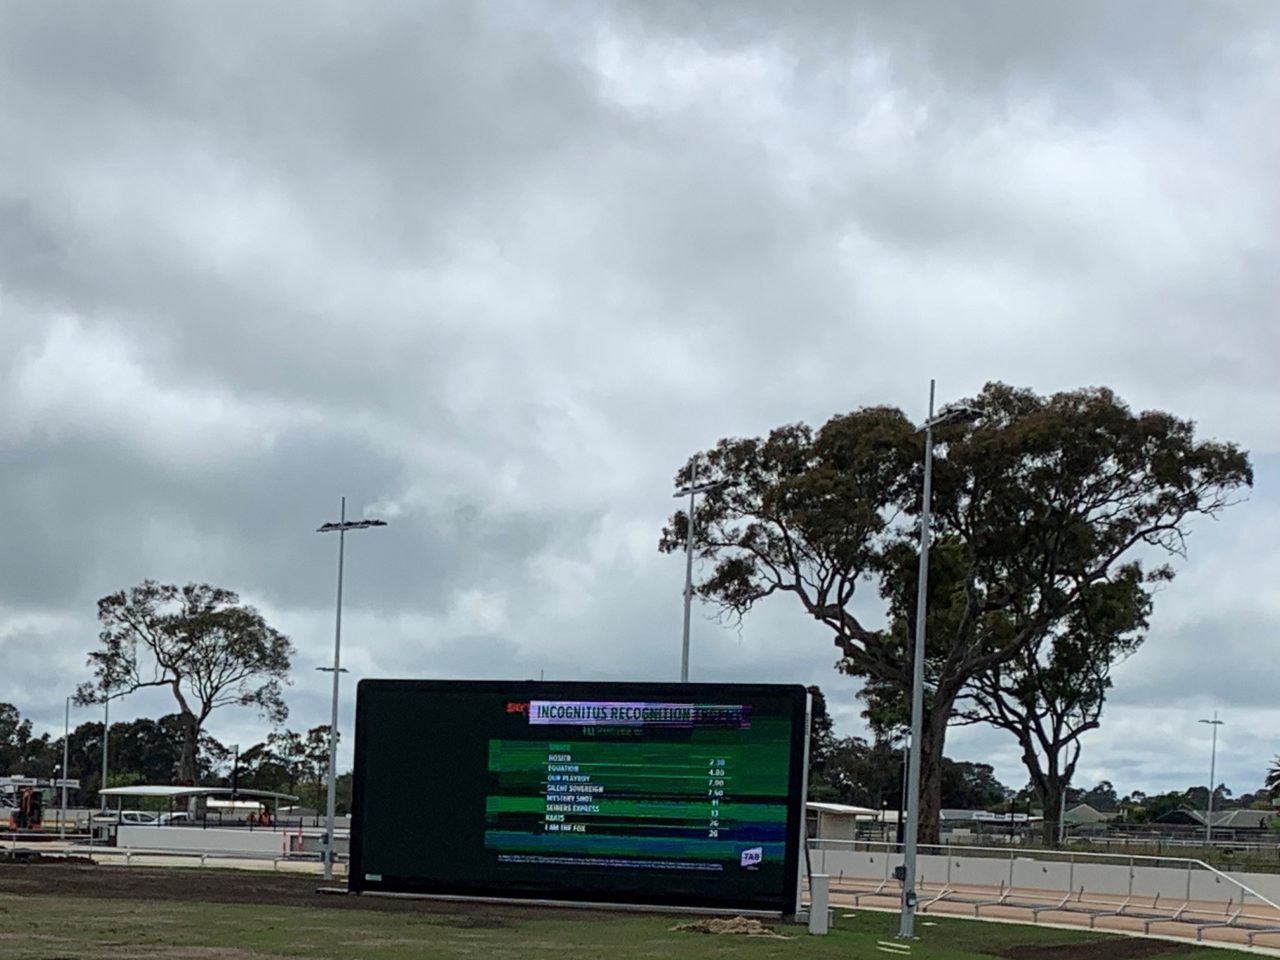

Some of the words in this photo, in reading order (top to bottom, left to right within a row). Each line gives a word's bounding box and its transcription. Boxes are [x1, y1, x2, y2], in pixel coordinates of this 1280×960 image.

[536, 704, 607, 719] INCOGNITUS
[610, 706, 692, 721] RECOGNITION
[743, 852, 761, 861] TAB
